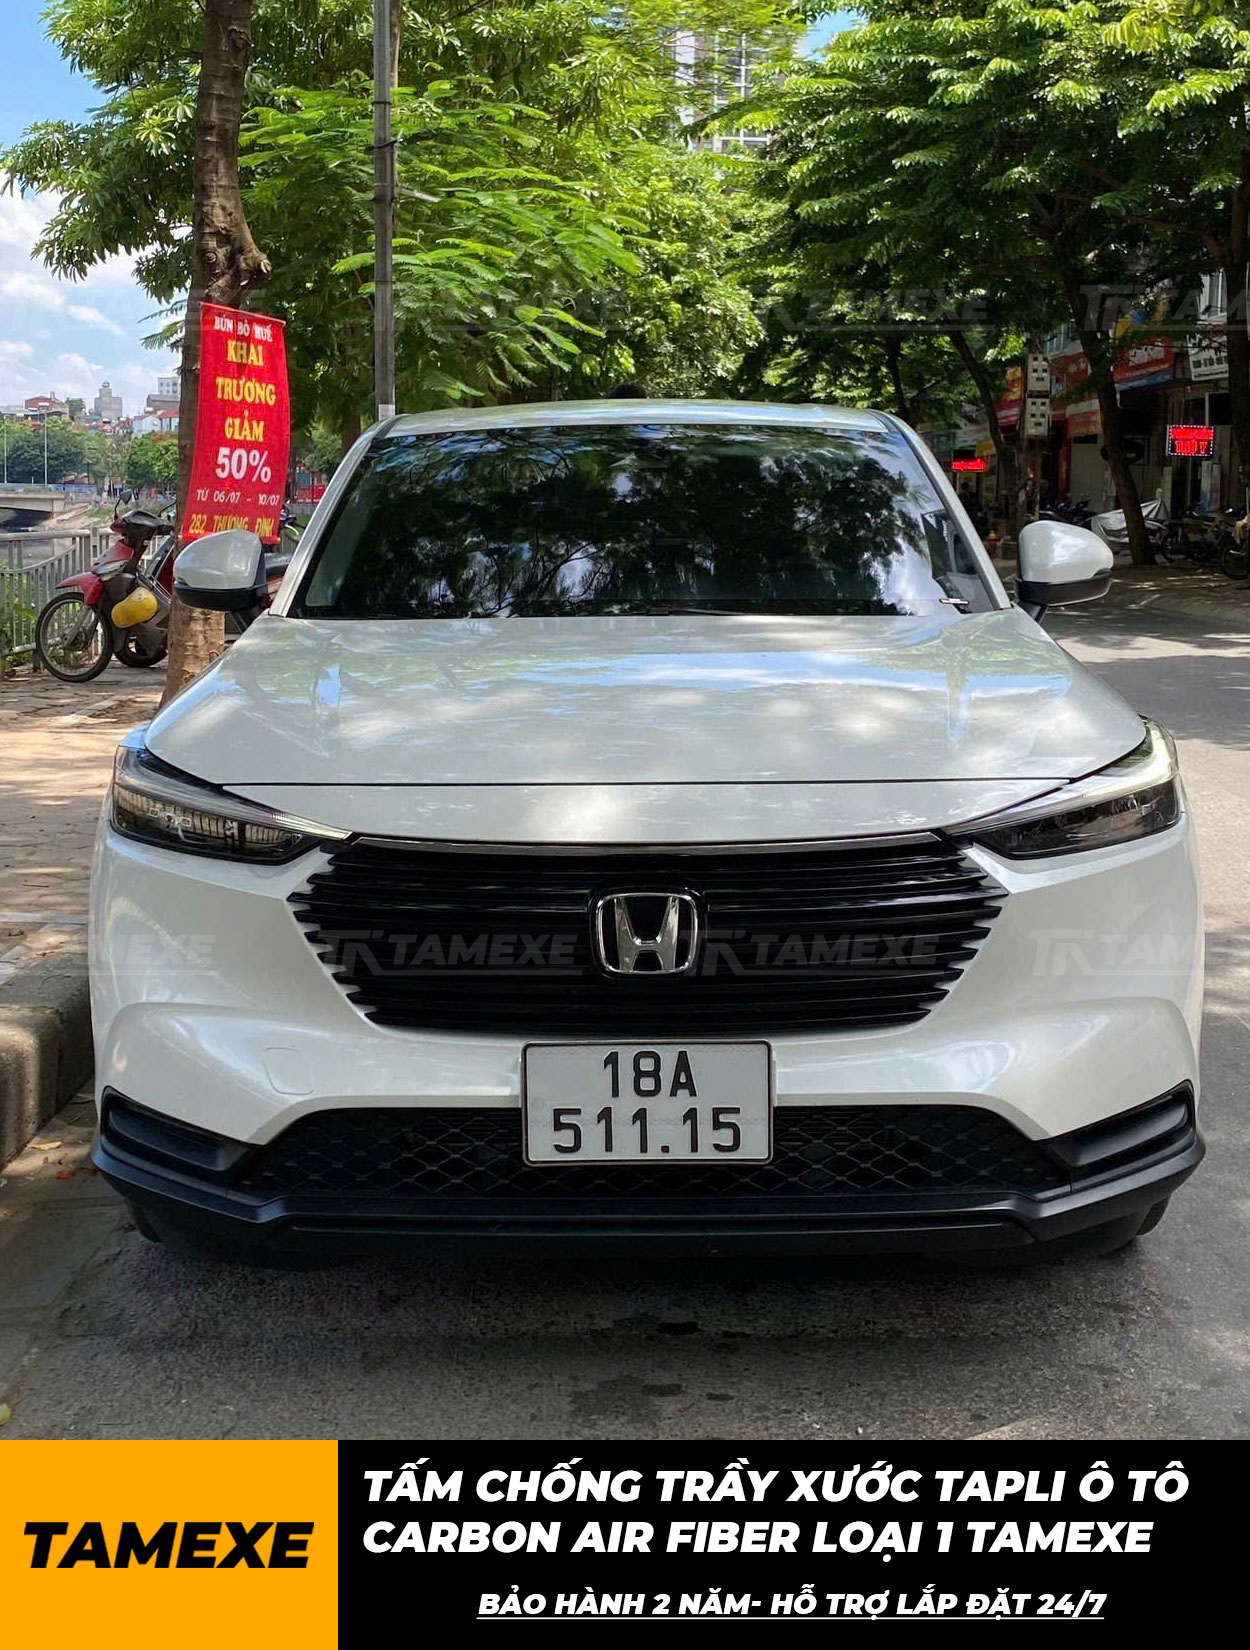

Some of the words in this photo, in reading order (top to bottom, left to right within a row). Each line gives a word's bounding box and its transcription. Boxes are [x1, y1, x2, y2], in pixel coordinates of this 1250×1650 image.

[213, 315, 233, 333] BÚN
[237, 319, 250, 337] BÒ
[253, 324, 273, 342] HUẾ
[227, 339, 264, 366] KHAI
[216, 376, 276, 406] TRƯƠNG
[225, 410, 264, 442] GIẢM
[215, 447, 272, 483] 50%
[213, 490, 241, 503] 06/07
[258, 493, 280, 506] 10/07
[189, 514, 207, 534] 282
[603, 1050, 697, 1098] 18A
[553, 1106, 741, 1154] 511.15
